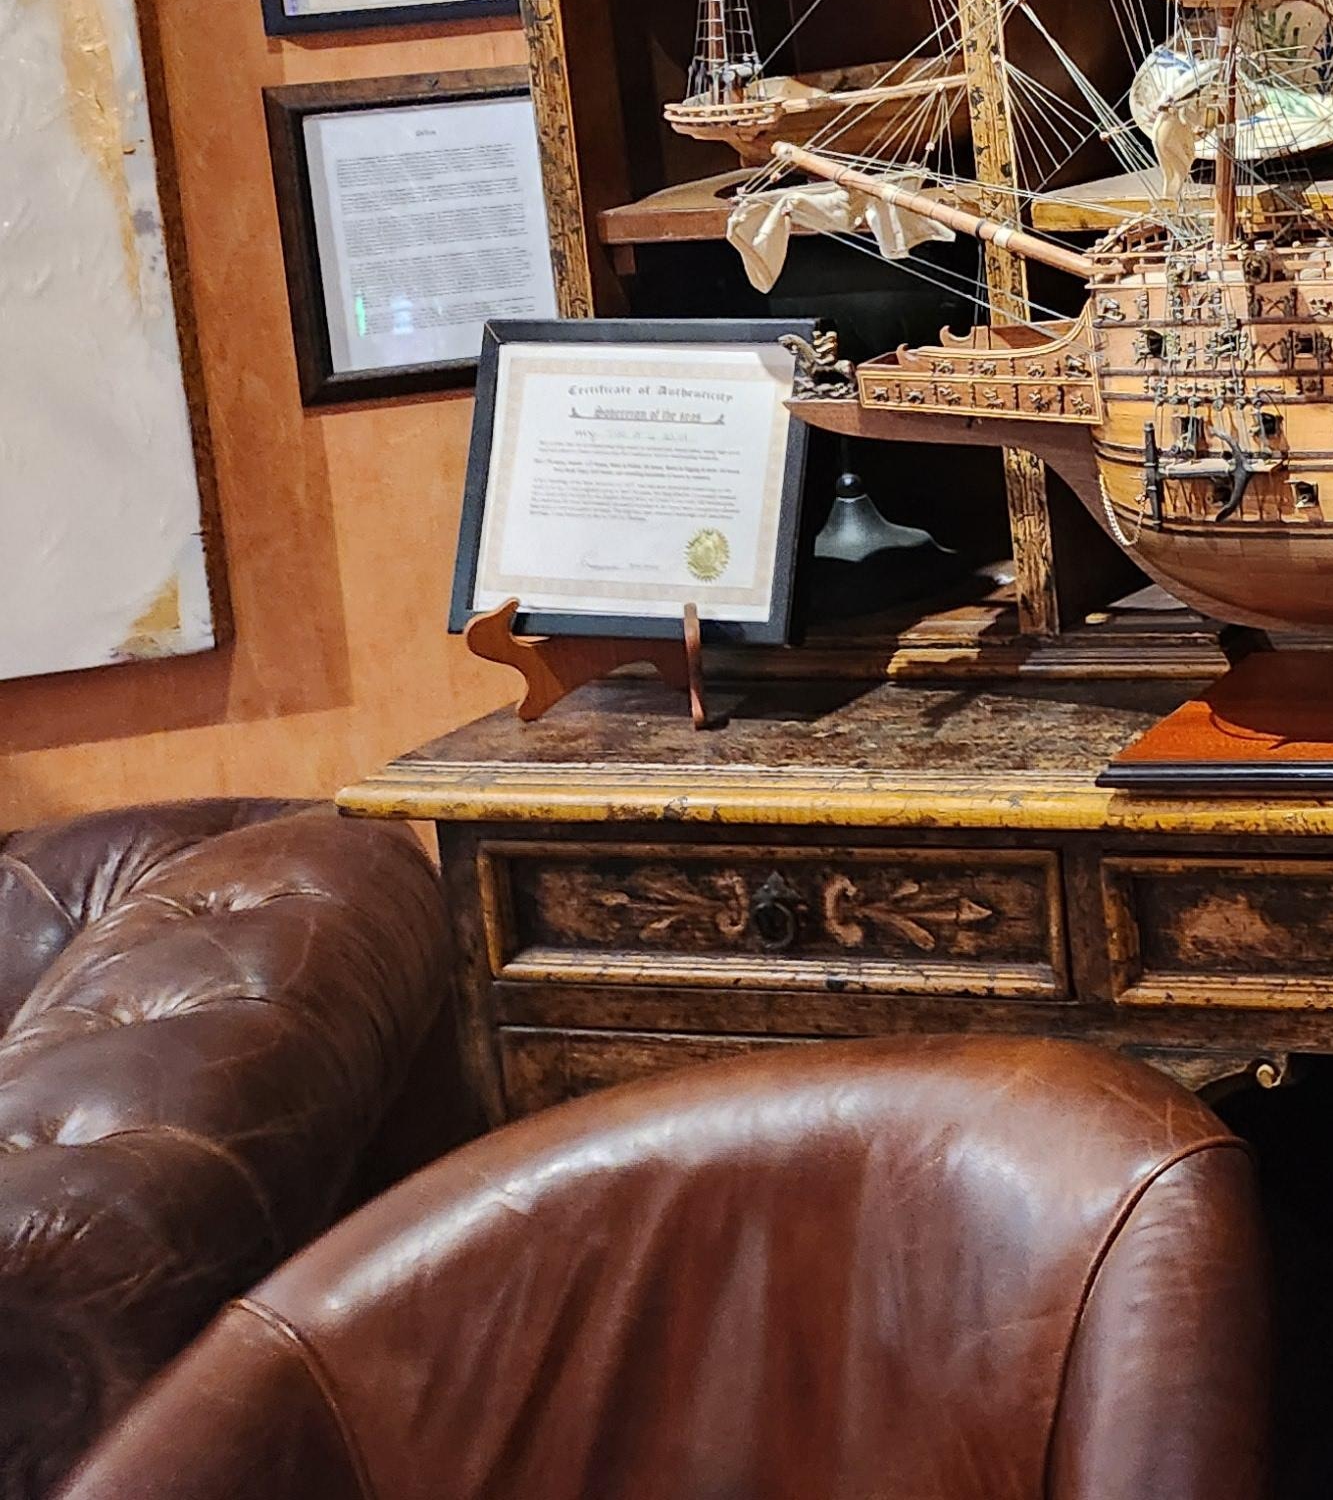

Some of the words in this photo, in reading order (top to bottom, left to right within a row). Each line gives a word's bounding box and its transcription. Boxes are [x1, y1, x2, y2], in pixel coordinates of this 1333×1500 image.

[568, 384, 631, 395] Certificate
[638, 385, 650, 396] of
[657, 384, 734, 402] Authenticity
